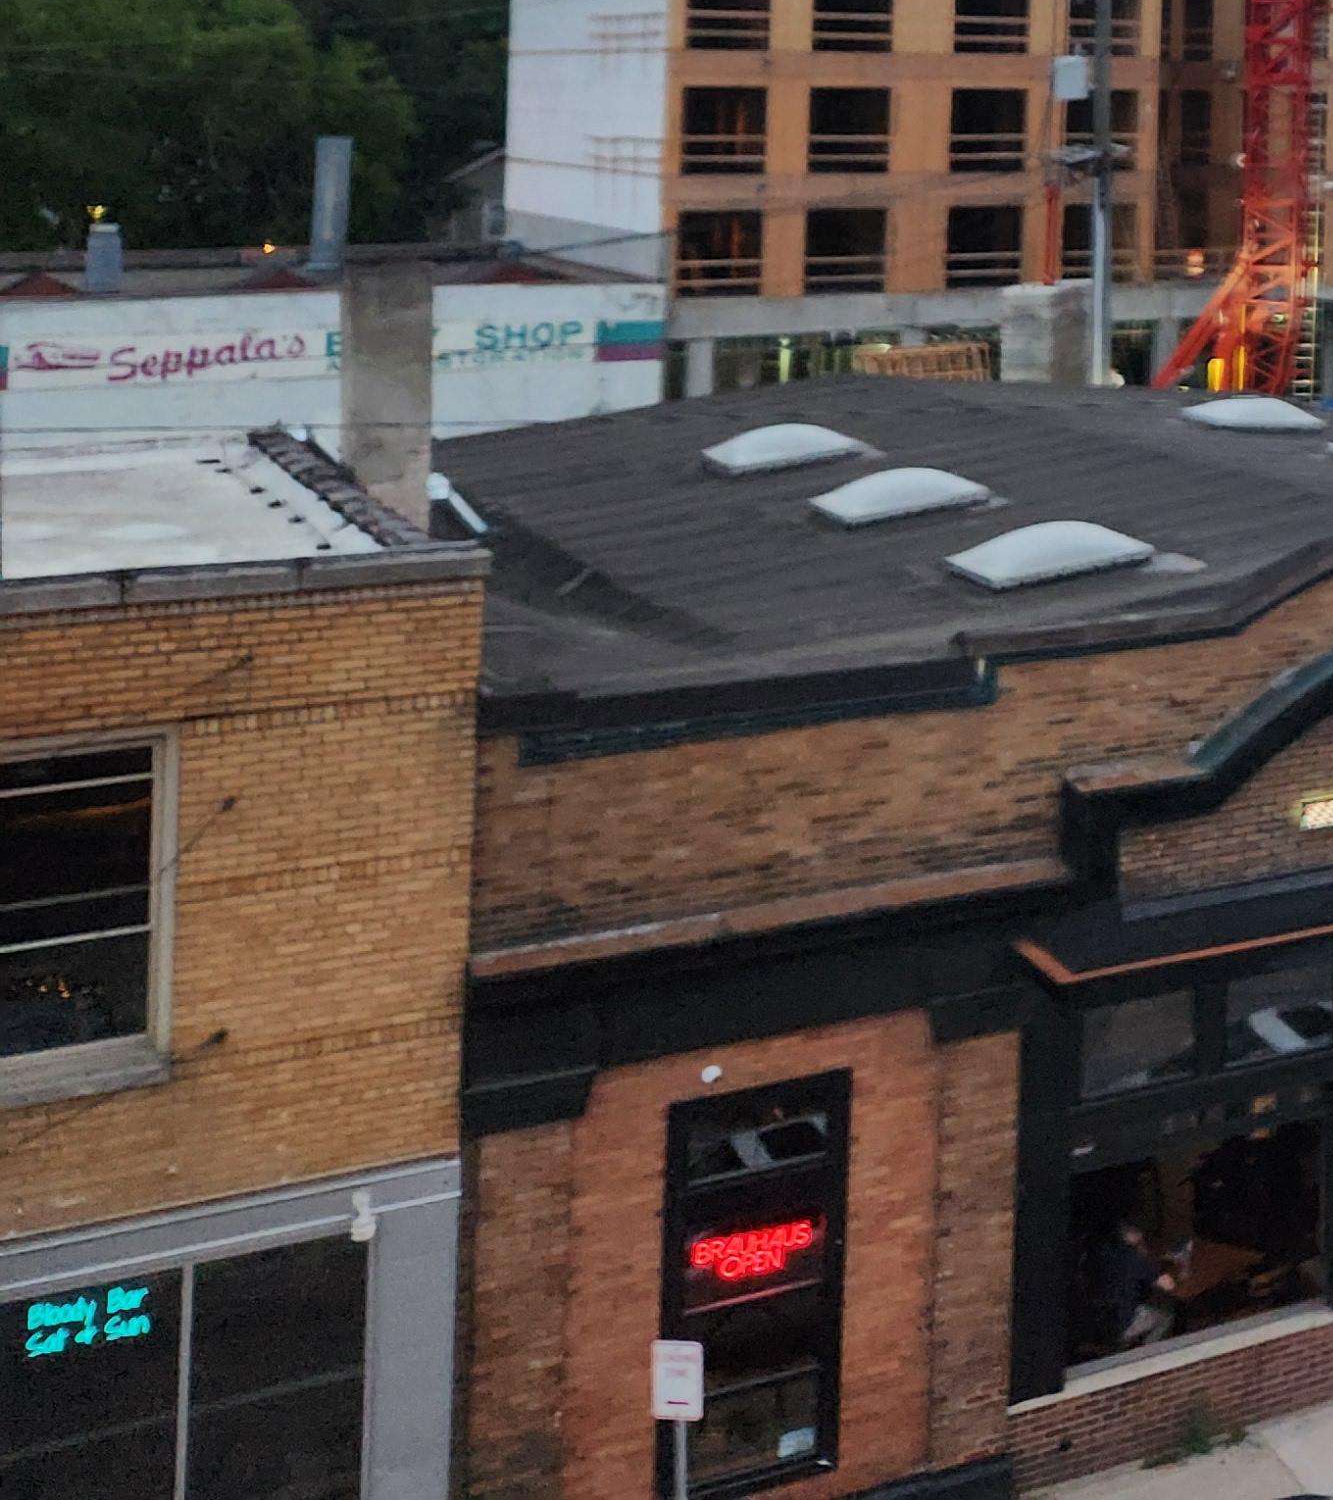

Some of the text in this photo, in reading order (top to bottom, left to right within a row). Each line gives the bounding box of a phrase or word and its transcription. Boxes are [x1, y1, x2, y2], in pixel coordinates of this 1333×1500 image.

[107, 331, 306, 381] Seppala's
[474, 320, 584, 350] SHOP
[691, 1219, 814, 1268] BRAUHAUS
[719, 1249, 787, 1281] OPEN
[27, 1286, 149, 1330] Bloody Bar
[25, 1327, 69, 1358] Sat
[104, 1314, 150, 1341] Sun
